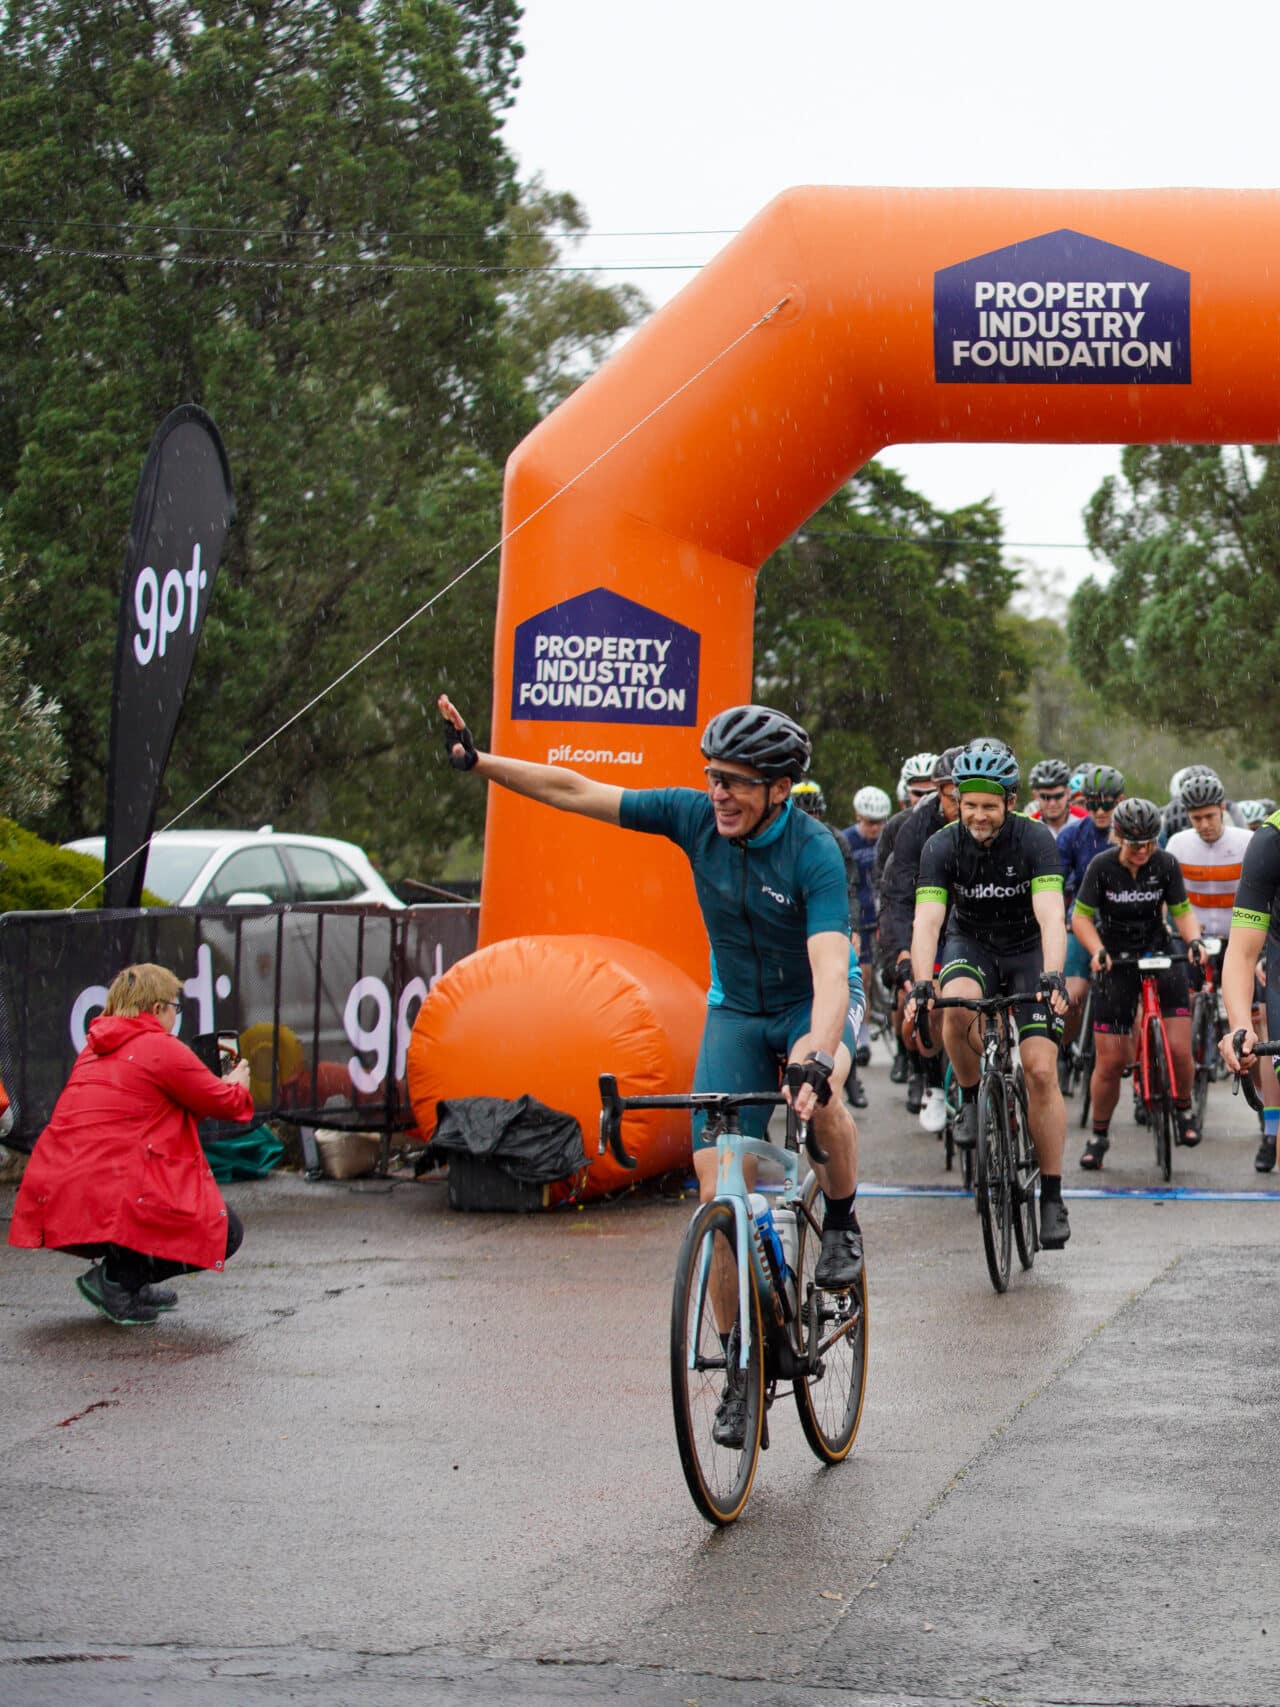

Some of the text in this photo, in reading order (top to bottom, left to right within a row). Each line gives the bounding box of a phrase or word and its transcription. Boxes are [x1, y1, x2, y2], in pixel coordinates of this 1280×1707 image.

[974, 281, 1150, 309] PROPERTY
[978, 311, 1146, 339] INDUSTRY
[952, 341, 1172, 368] FOUNDATION
[133, 542, 207, 666] gpt
[534, 635, 672, 662] PROPERTY
[536, 659, 667, 686] INDUSTRY
[519, 683, 686, 711] FOUNDATION
[548, 745, 643, 765] pif.com.au
[343, 943, 443, 1093] gp
